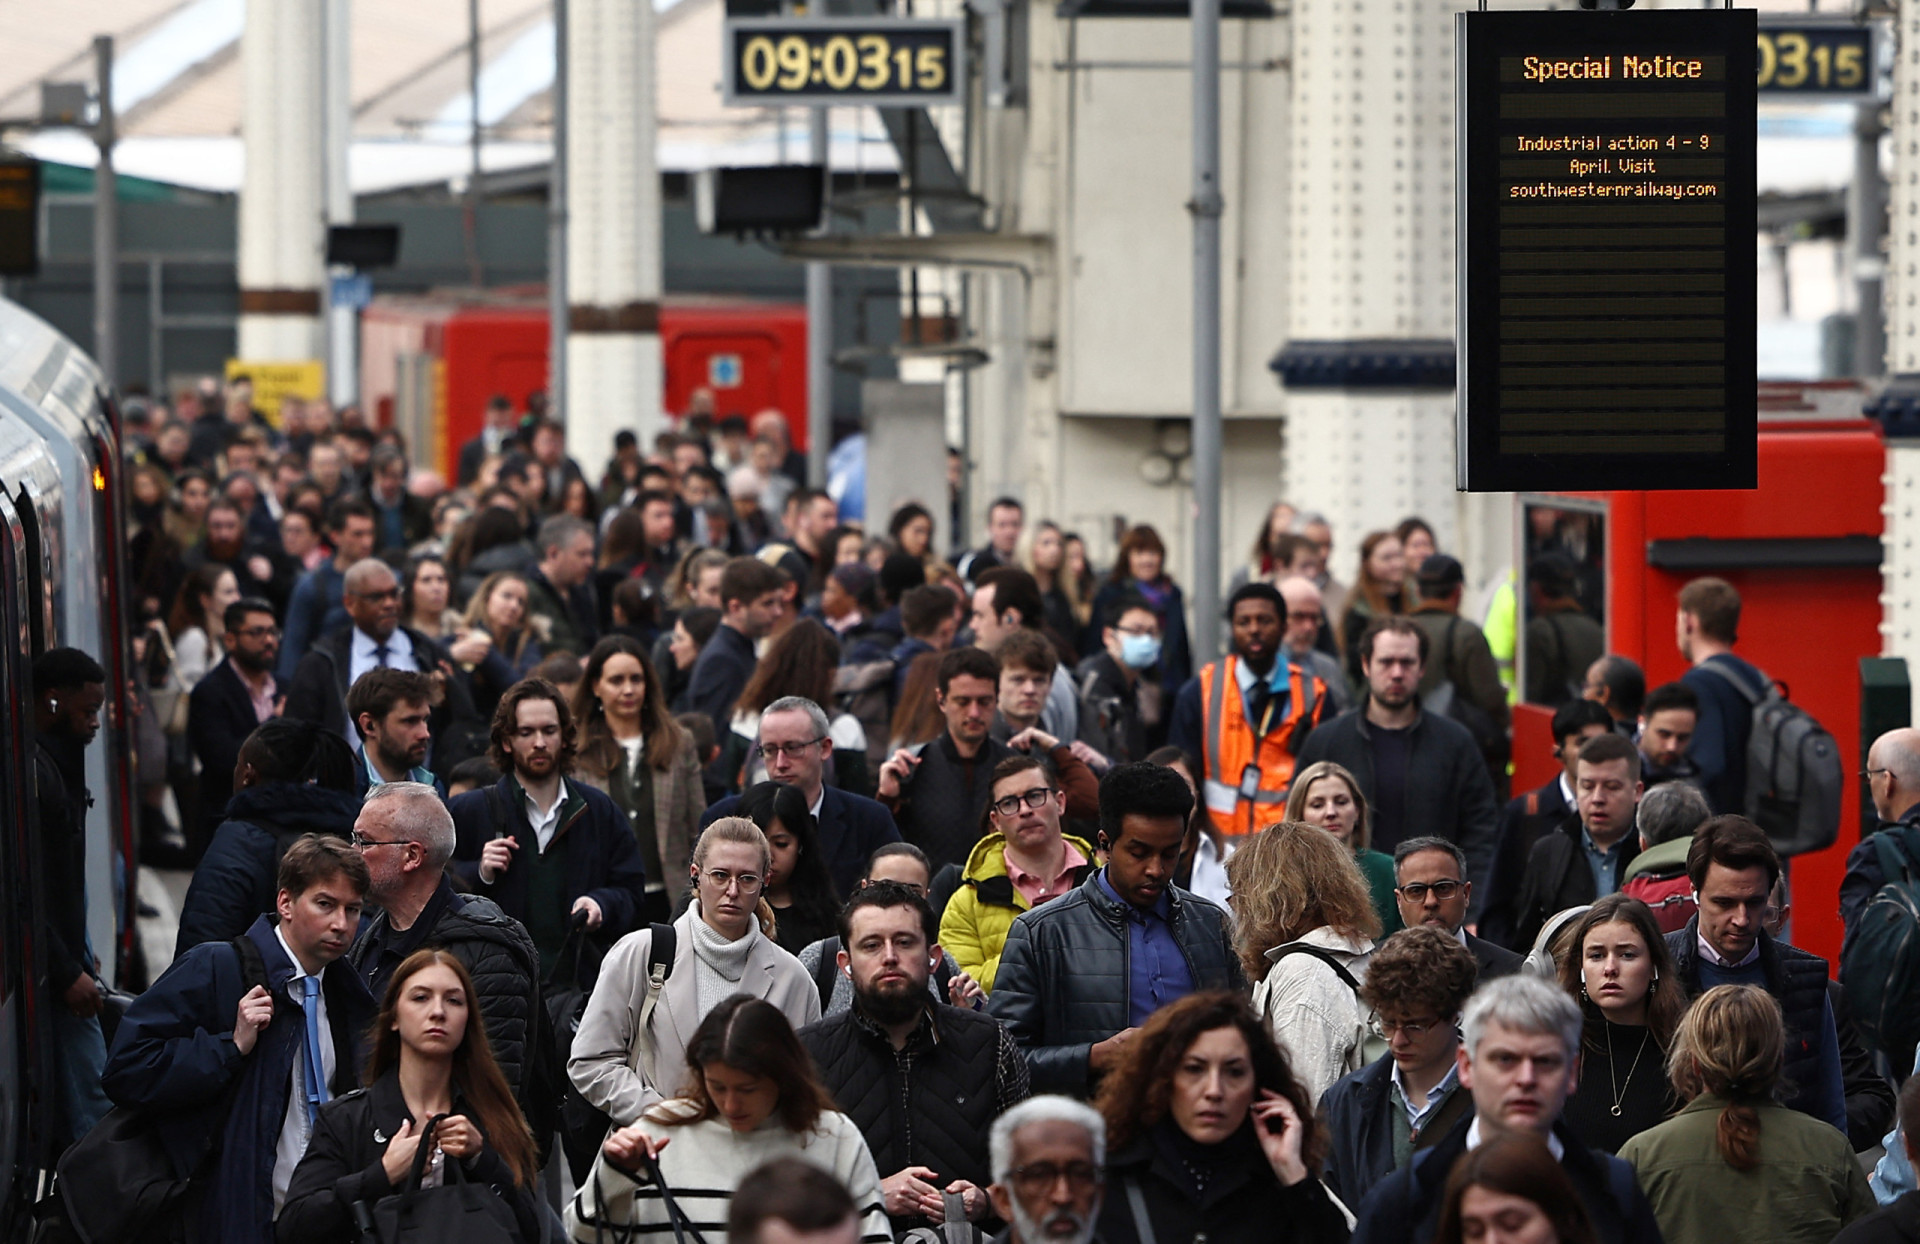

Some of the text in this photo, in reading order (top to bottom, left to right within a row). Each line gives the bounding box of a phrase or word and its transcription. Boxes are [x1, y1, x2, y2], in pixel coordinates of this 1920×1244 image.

[743, 36, 945, 89] 09:03 15
[1523, 55, 1702, 83] Special Notice
[1517, 135, 1600, 151] Industrial
[1607, 135, 1658, 151] action
[1665, 135, 1675, 150] 4
[1699, 134, 1709, 150] 9
[1569, 158, 1656, 177] April. Visit
[1510, 182, 1717, 200] southwesternrailway.com
